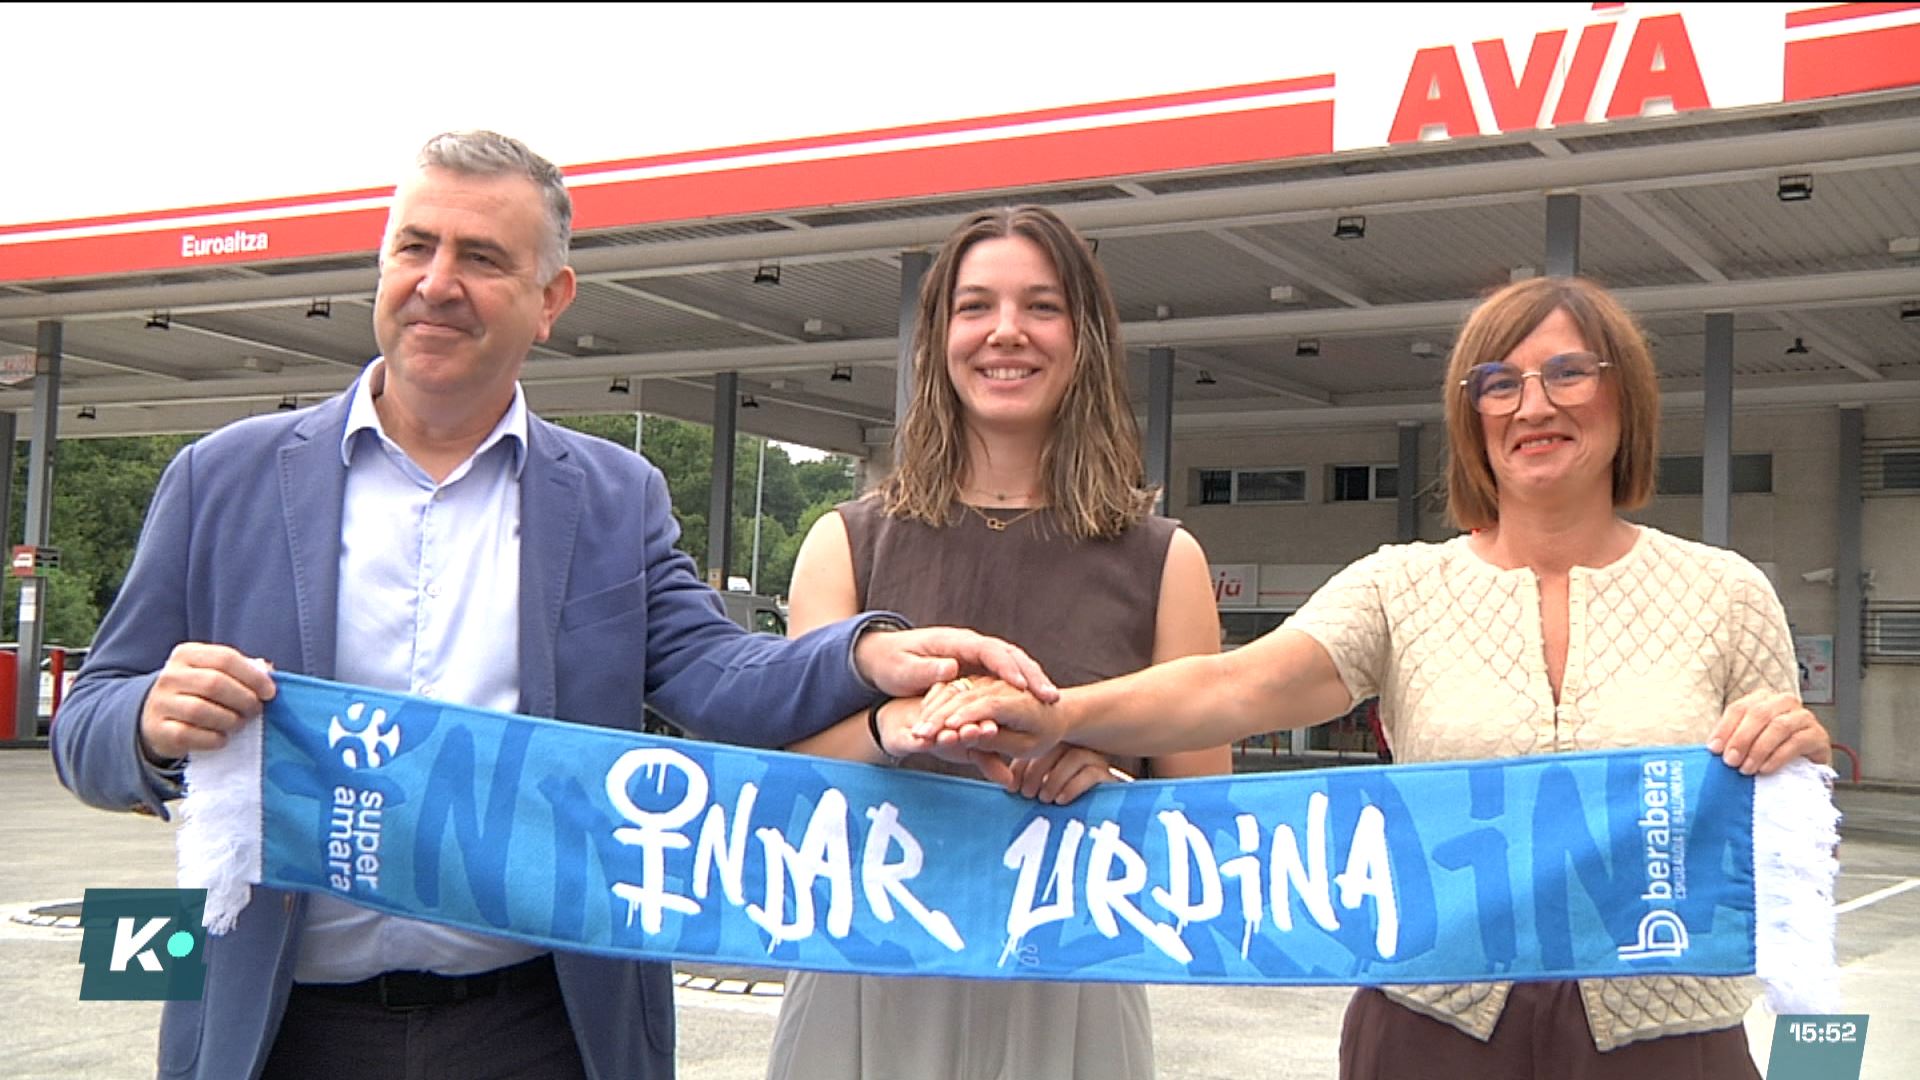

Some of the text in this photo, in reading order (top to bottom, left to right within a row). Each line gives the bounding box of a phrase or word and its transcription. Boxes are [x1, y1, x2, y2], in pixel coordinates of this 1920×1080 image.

[182, 230, 269, 258] Euroaltza
[328, 786, 357, 892] amara
[352, 790, 384, 890] super
[1638, 760, 1672, 900] berabera
